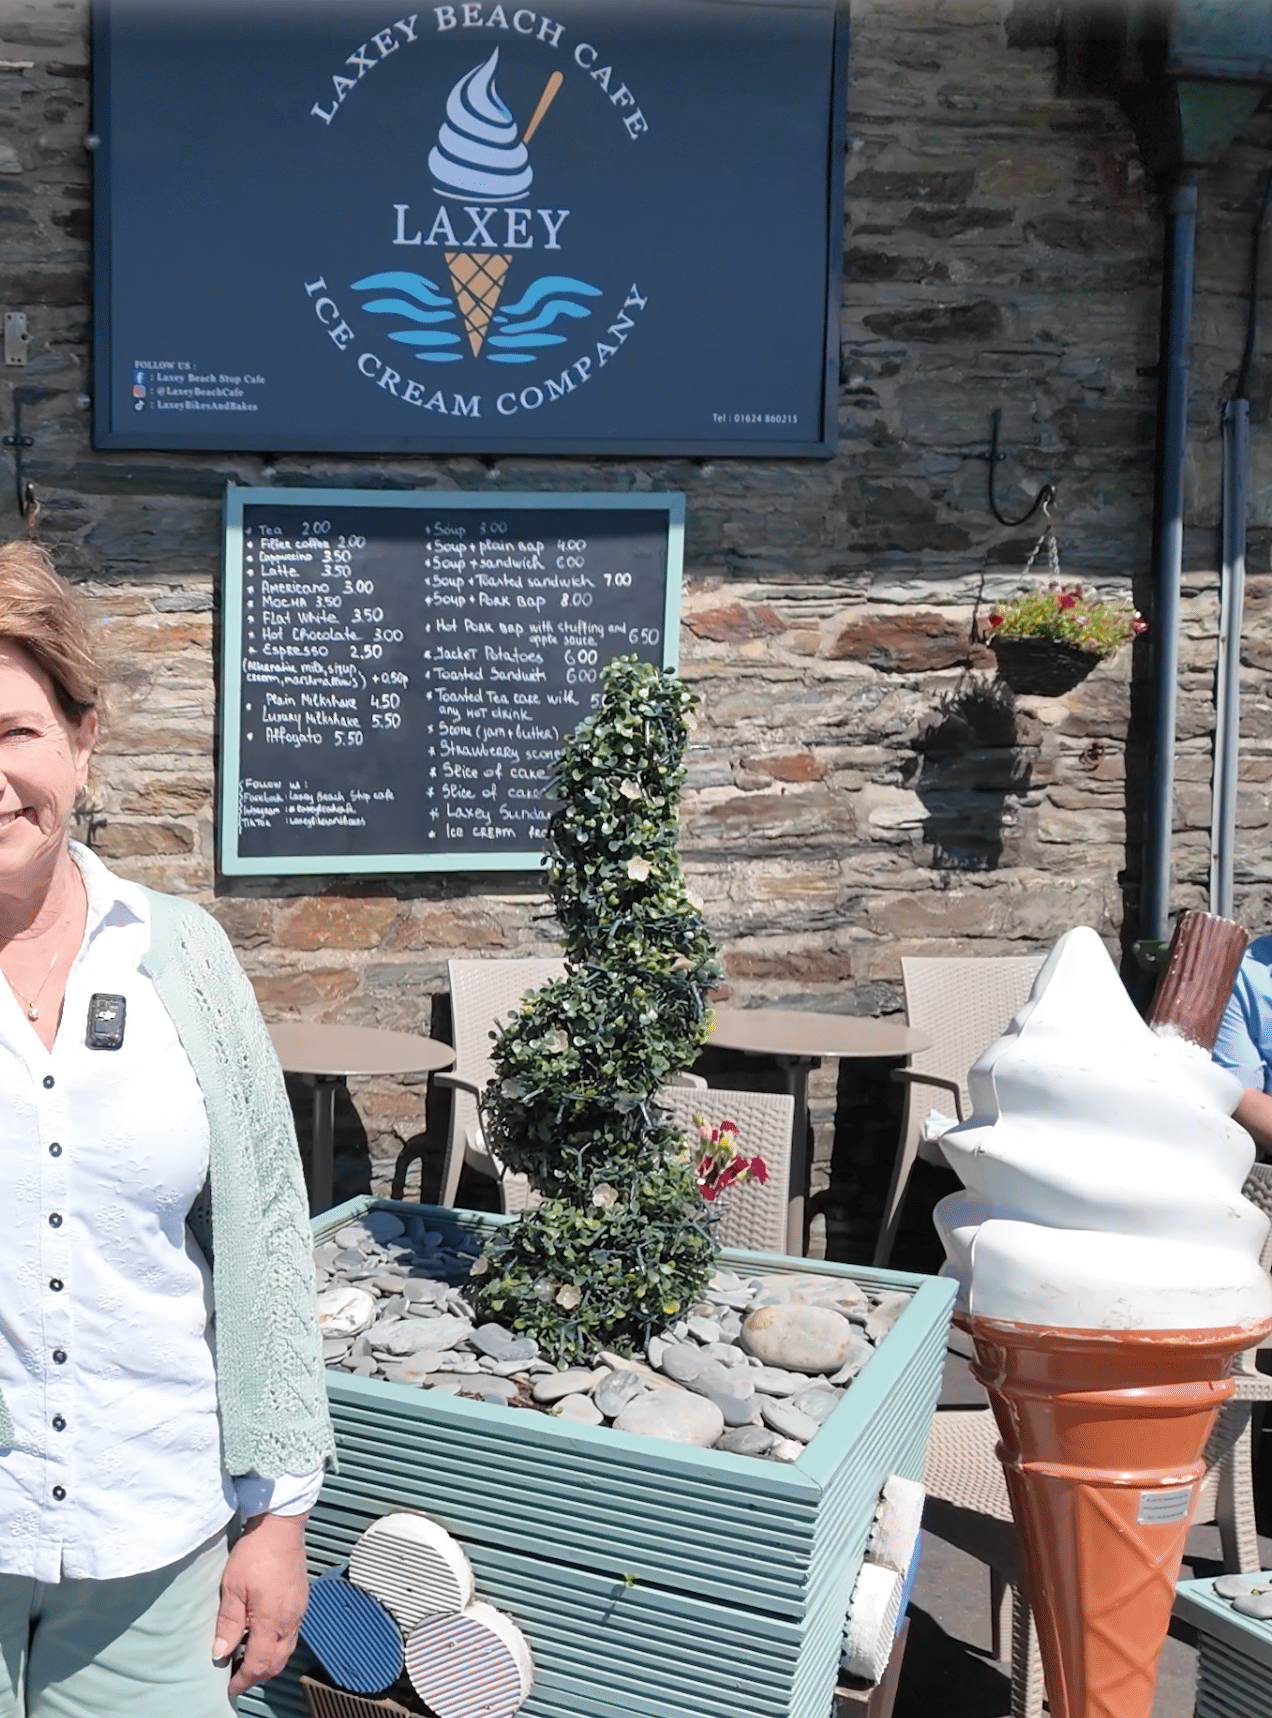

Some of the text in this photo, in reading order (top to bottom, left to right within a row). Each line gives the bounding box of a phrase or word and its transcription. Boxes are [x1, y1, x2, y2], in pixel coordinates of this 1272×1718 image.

[310, 2, 649, 140] LAXEY BEACH CAFE
[392, 203, 570, 249] LAXEY
[304, 276, 648, 418] ICE CREAM COMPANY
[134, 360, 175, 370] FOLLOW
[178, 361, 191, 370] US
[157, 372, 185, 384] Laxey
[188, 373, 217, 383] Beach
[219, 374, 242, 385] Stop
[244, 374, 266, 385] Cafe
[713, 412, 726, 423] Tel
[734, 413, 762, 423] 01624
[258, 524, 283, 535] Tea
[434, 521, 466, 538] Soup
[295, 538, 331, 551] coffee
[434, 540, 467, 557] Soup
[479, 539, 515, 556] plain
[261, 564, 301, 577] Latte
[433, 556, 466, 573] Soup
[478, 554, 546, 571] sandwich
[432, 574, 465, 592] Soup
[475, 573, 524, 588] Toasted
[527, 574, 596, 588] sandwich
[433, 591, 466, 608] Soup
[561, 592, 593, 608] 8.00
[297, 609, 340, 624] White
[262, 627, 283, 641] Hot
[292, 626, 365, 641] Chocolate
[436, 618, 458, 632] Hot
[529, 619, 554, 634] with
[557, 618, 605, 639] stuffing
[608, 621, 627, 634] and
[529, 634, 598, 649] apple sauce
[349, 643, 383, 660] 2.50
[484, 645, 544, 664] Potatoes
[433, 666, 484, 682] Toasted
[266, 692, 296, 707] Plain
[370, 693, 401, 709] 4.50
[434, 687, 483, 703] Toasted
[487, 689, 510, 704] Tea
[547, 689, 580, 706] with
[372, 713, 402, 729] 5.50
[439, 706, 461, 724] any
[492, 705, 534, 721] drink
[266, 727, 364, 748] Affogato 5.50
[439, 723, 473, 737] Scone
[443, 761, 478, 779] Slice
[483, 762, 503, 780] of
[442, 781, 476, 800] Slice
[482, 782, 497, 802] of
[446, 802, 492, 826] Laxey
[446, 823, 464, 839] Ice
